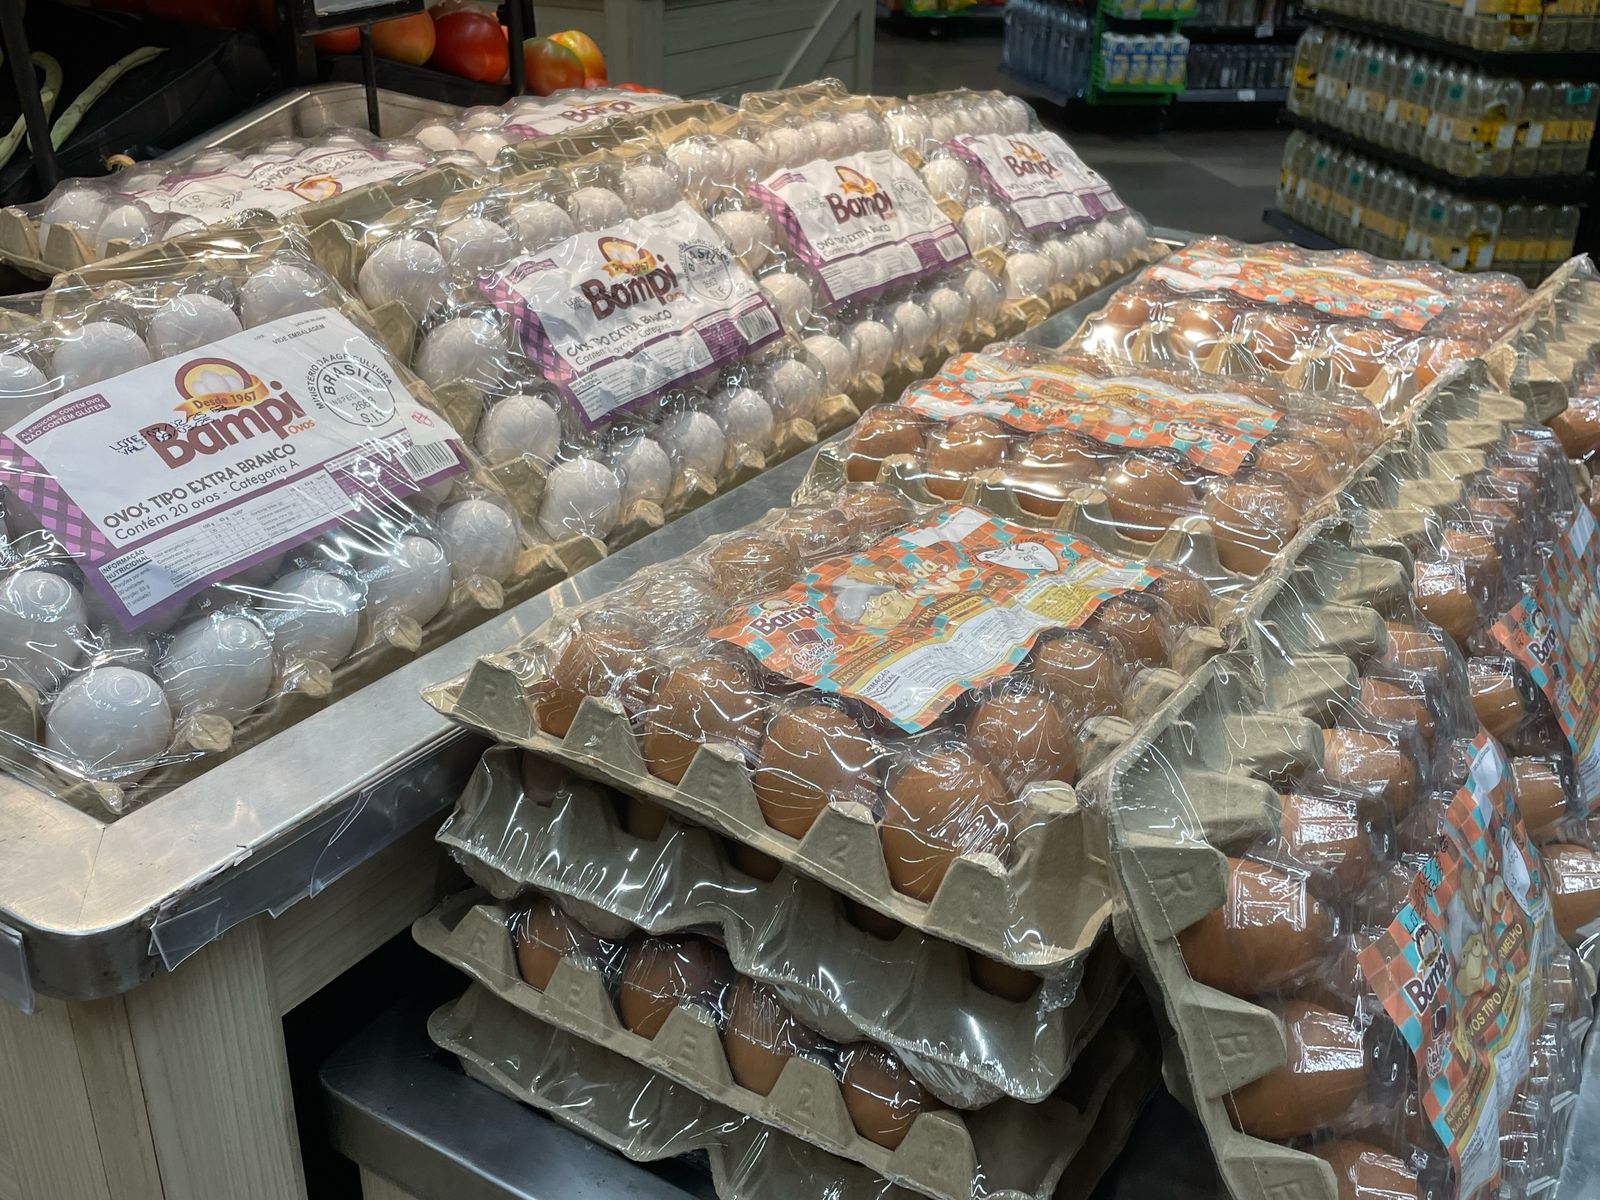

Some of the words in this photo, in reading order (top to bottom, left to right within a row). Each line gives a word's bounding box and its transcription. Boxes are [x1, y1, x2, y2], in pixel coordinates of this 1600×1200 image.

[825, 182, 894, 224] Bampi
[580, 254, 678, 321] Bampi
[288, 323, 326, 340] EMBALAGEM
[323, 364, 373, 396] BRASIL
[85, 397, 100, 406] OVO
[193, 395, 228, 409] Desde
[230, 391, 256, 405] 1967
[138, 380, 306, 470] Bampi
[286, 418, 315, 435] Ovos
[103, 502, 150, 529] OVOS
[147, 487, 188, 510] TIPO
[186, 467, 240, 494] EXTRA
[235, 443, 296, 473] BRANCO
[114, 512, 170, 540] Contém
[169, 503, 188, 518] 20
[192, 493, 220, 510] ovos
[229, 465, 287, 493] Categoria
[289, 459, 300, 469] A
[101, 549, 145, 574] INFORMAÇÃO
[106, 555, 150, 580] NUTRICIONAL
[749, 602, 820, 635] Bampi
[1151, 869, 1197, 903] R
[1482, 992, 1502, 1018] TIPO
[1214, 1032, 1255, 1063] B
